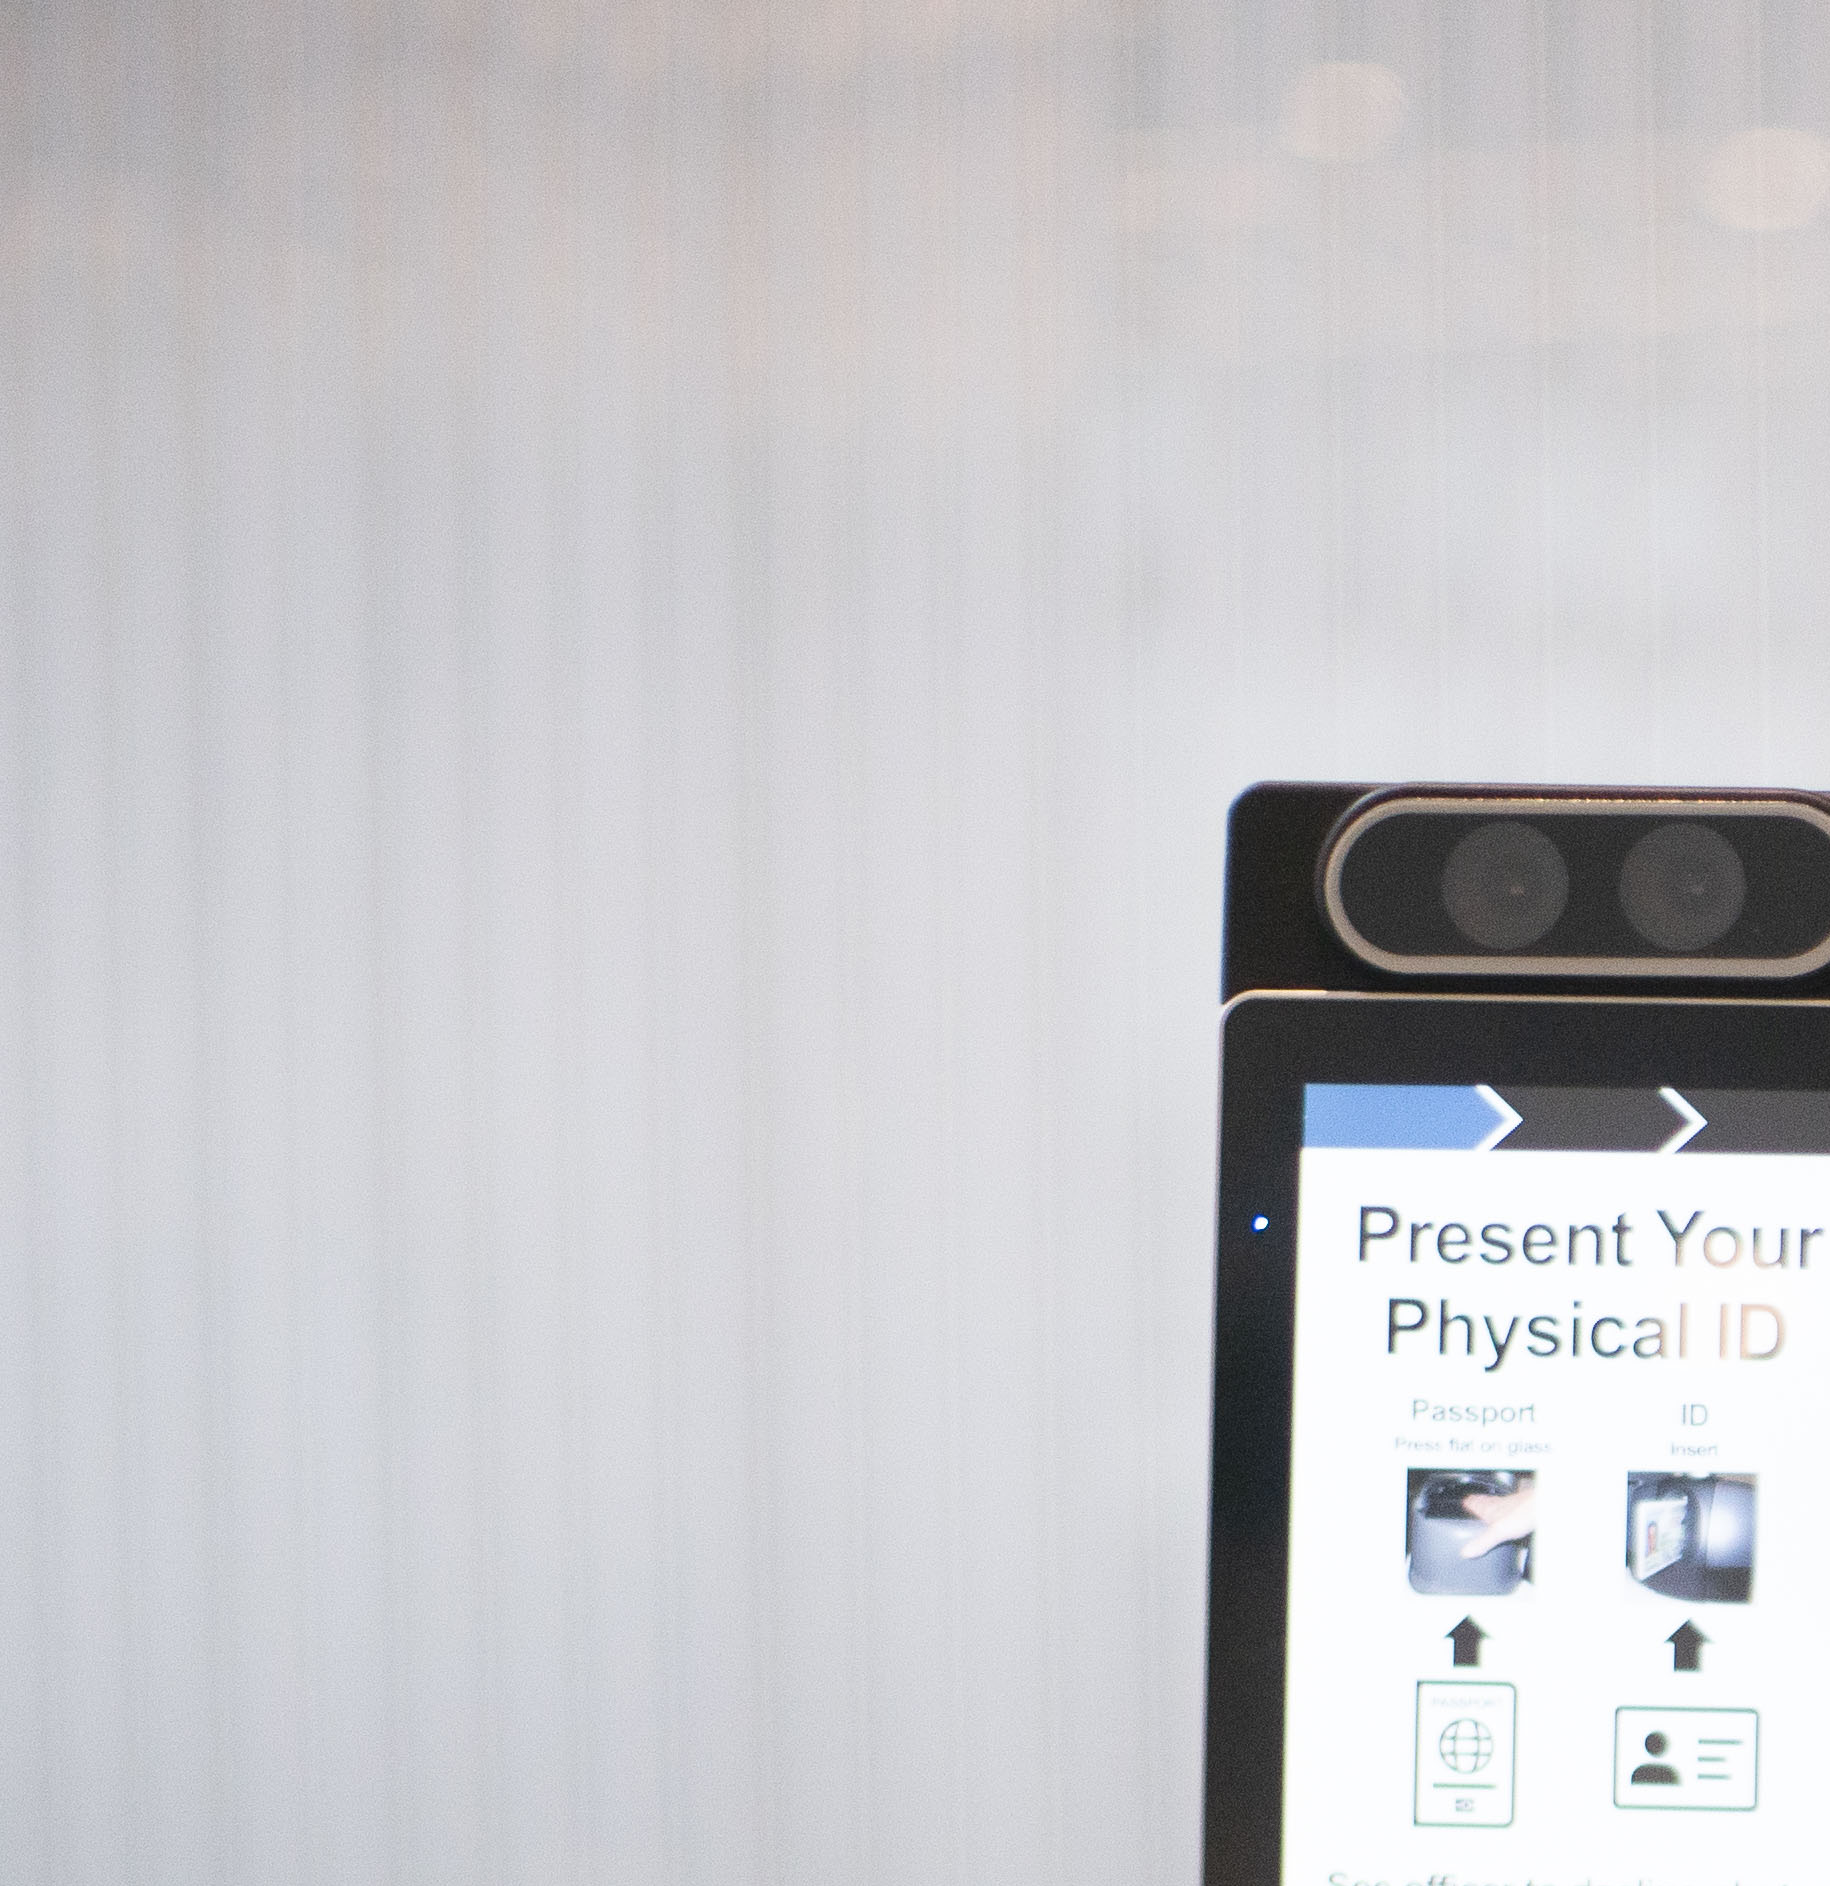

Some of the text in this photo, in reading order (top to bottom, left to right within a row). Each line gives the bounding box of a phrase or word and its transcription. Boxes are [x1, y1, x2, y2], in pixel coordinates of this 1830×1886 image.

[1358, 1205, 1825, 1270] Present Your
[1386, 1296, 1786, 1374] Physical ID
[1411, 1398, 1536, 1427] Passport
[1681, 1402, 1709, 1427] ID
[1393, 1435, 1443, 1453] Press
[1507, 1440, 1554, 1458] glass
[1669, 1441, 1719, 1457] Insert
